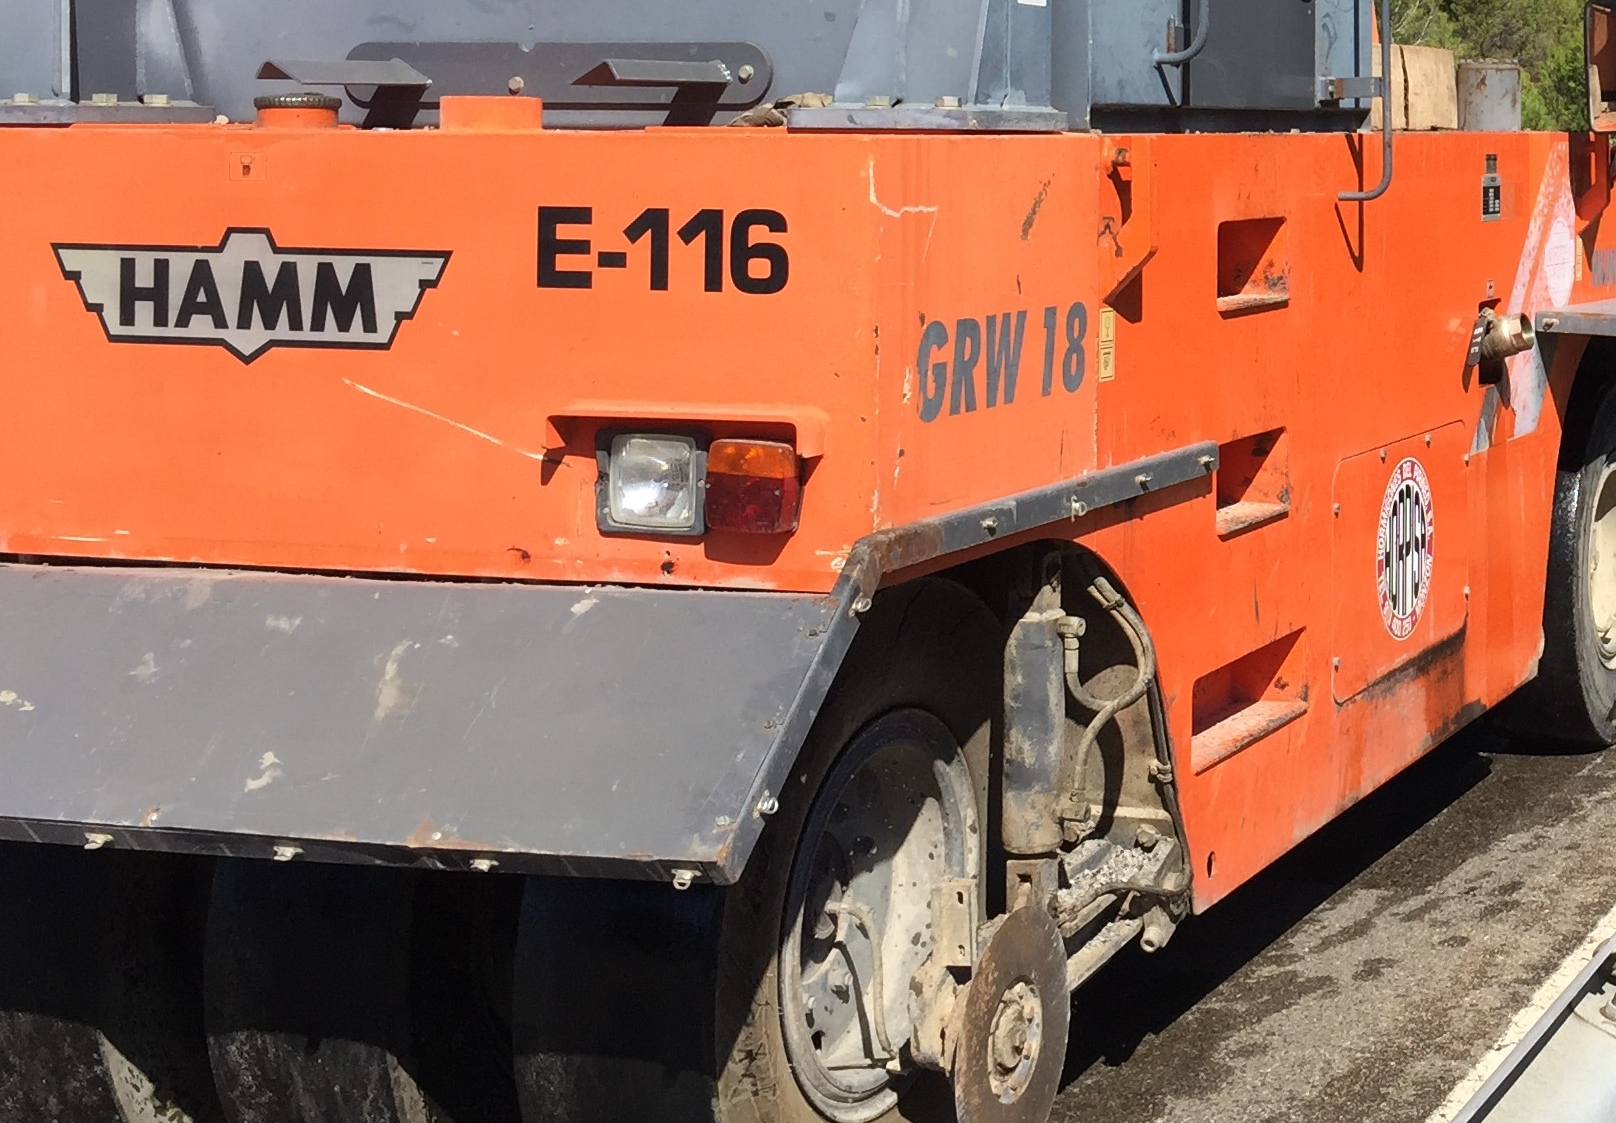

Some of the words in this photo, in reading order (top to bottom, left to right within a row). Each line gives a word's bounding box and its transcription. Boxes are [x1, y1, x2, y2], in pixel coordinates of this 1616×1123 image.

[537, 206, 789, 294] E-116
[118, 257, 378, 334] HAMM
[917, 310, 1027, 423] GRW
[1042, 301, 1087, 397] 18
